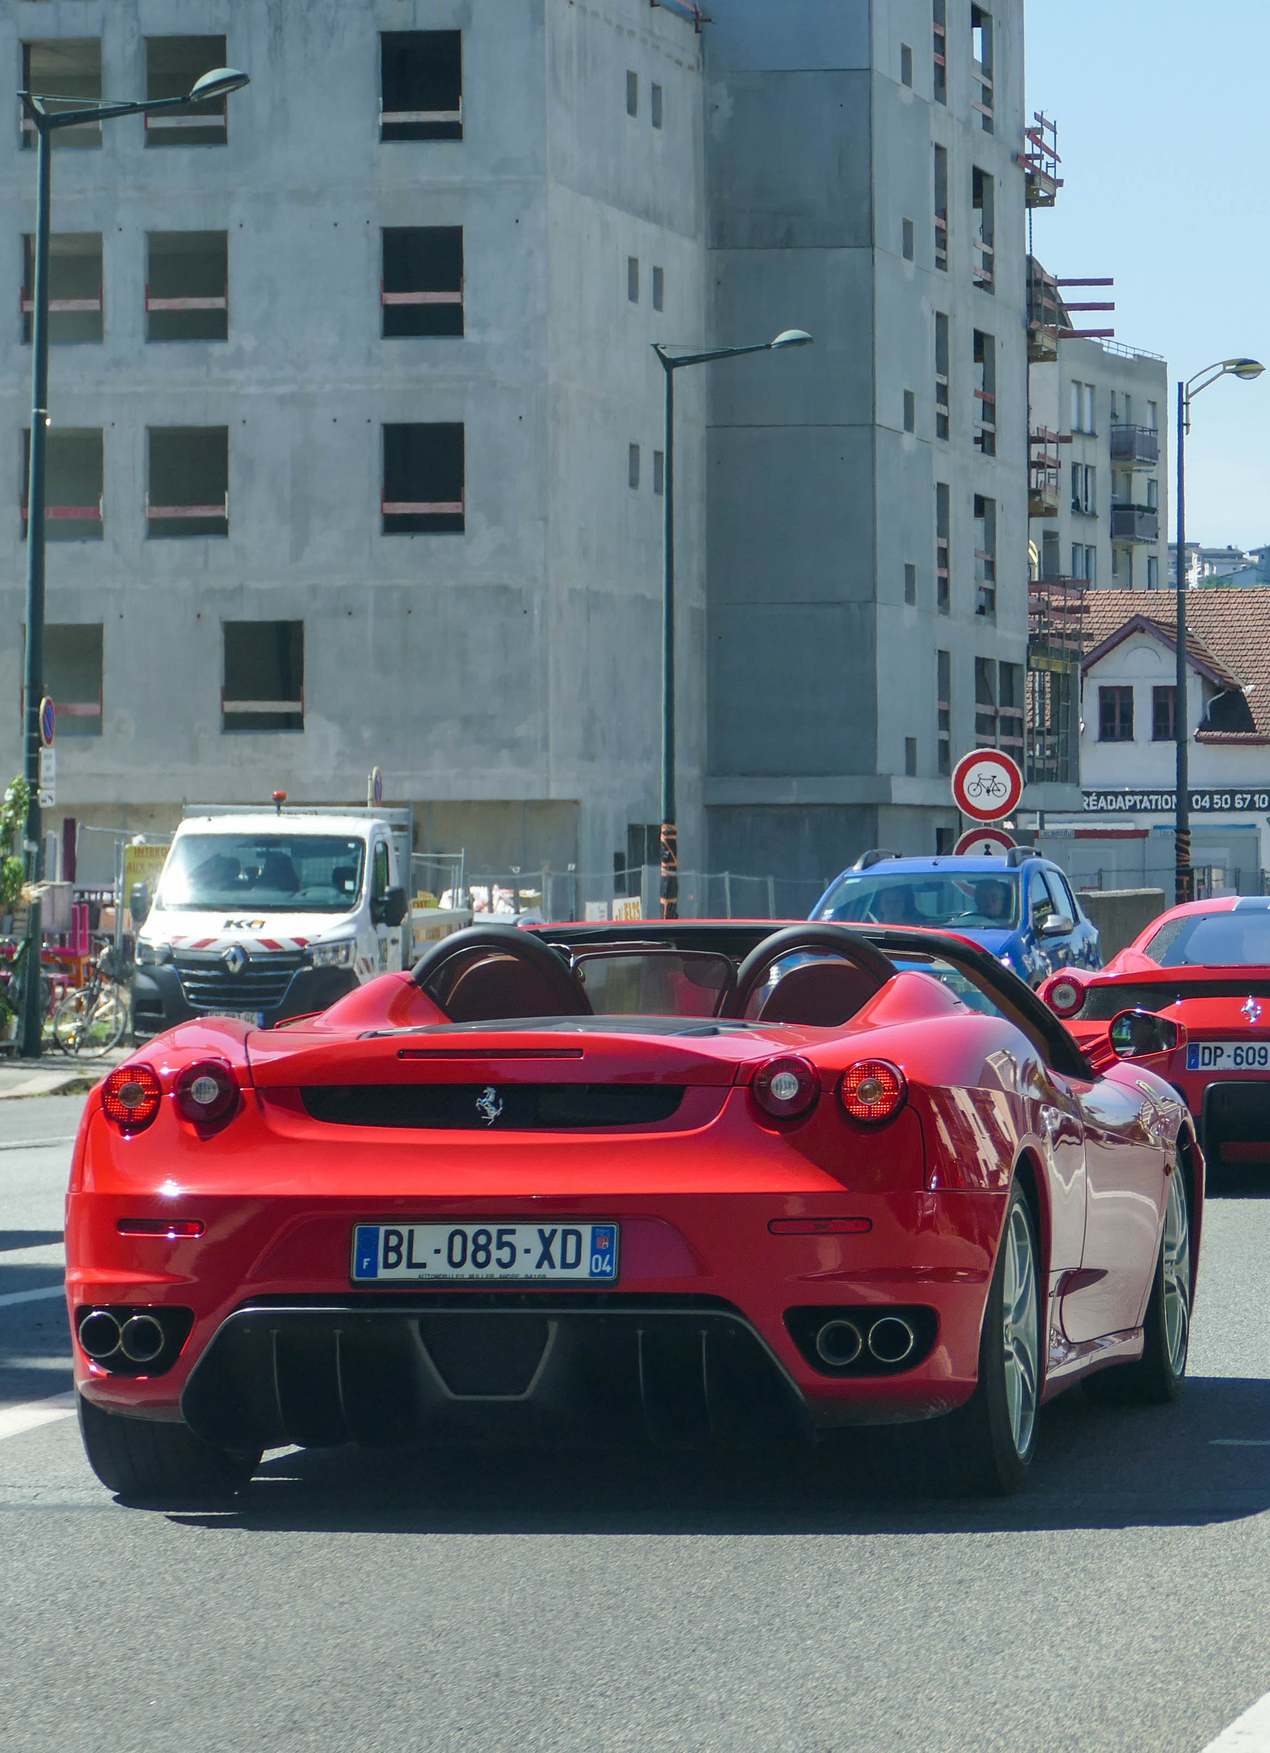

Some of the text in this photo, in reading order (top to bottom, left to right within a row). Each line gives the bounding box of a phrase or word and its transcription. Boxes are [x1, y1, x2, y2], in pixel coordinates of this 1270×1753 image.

[1191, 794, 1210, 809] 04
[1212, 794, 1231, 809] 50
[1234, 793, 1251, 809] 67
[1253, 793, 1269, 808] 10
[382, 1228, 583, 1270] BL-085-XD
[362, 1257, 371, 1270] F
[590, 1254, 612, 1274] 04
